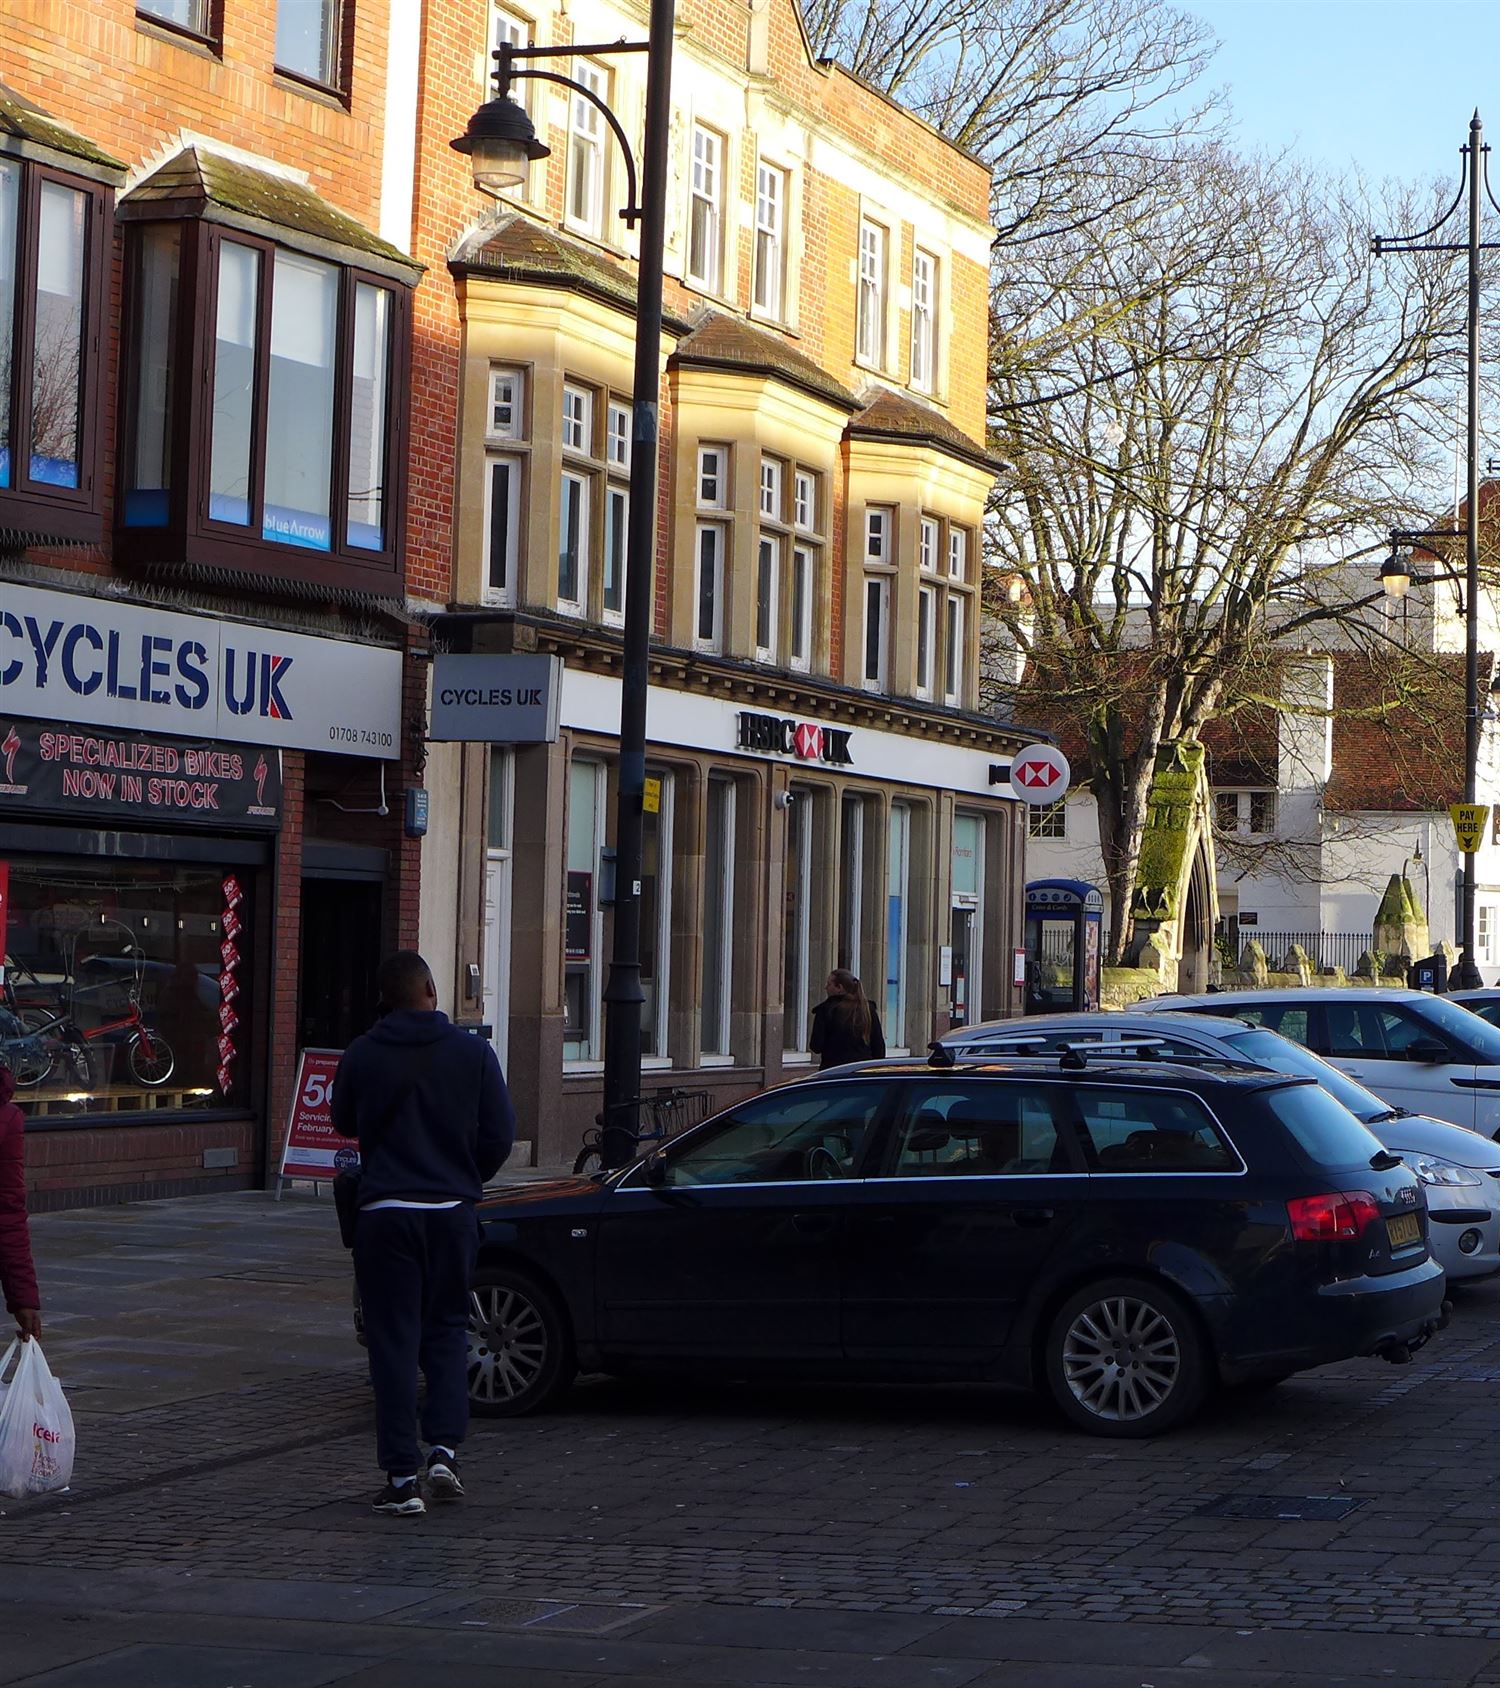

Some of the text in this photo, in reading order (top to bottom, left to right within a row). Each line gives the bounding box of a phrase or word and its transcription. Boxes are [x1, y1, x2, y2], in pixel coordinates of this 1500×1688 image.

[265, 514, 325, 540] blueArrow
[0, 611, 294, 721] CYCLES UK
[440, 689, 542, 706] CYCLES UK
[329, 726, 392, 747] 01708 743100
[737, 711, 855, 765] HSBC UK
[39, 732, 243, 781] SPECIALIZED BIKES
[62, 768, 219, 810] NOW IN STOCK
[1459, 810, 1475, 821] PAY
[1457, 822, 1478, 833] HERE
[1423, 971, 1431, 981] P
[299, 1111, 332, 1123] Servicin
[297, 1122, 334, 1135] February
